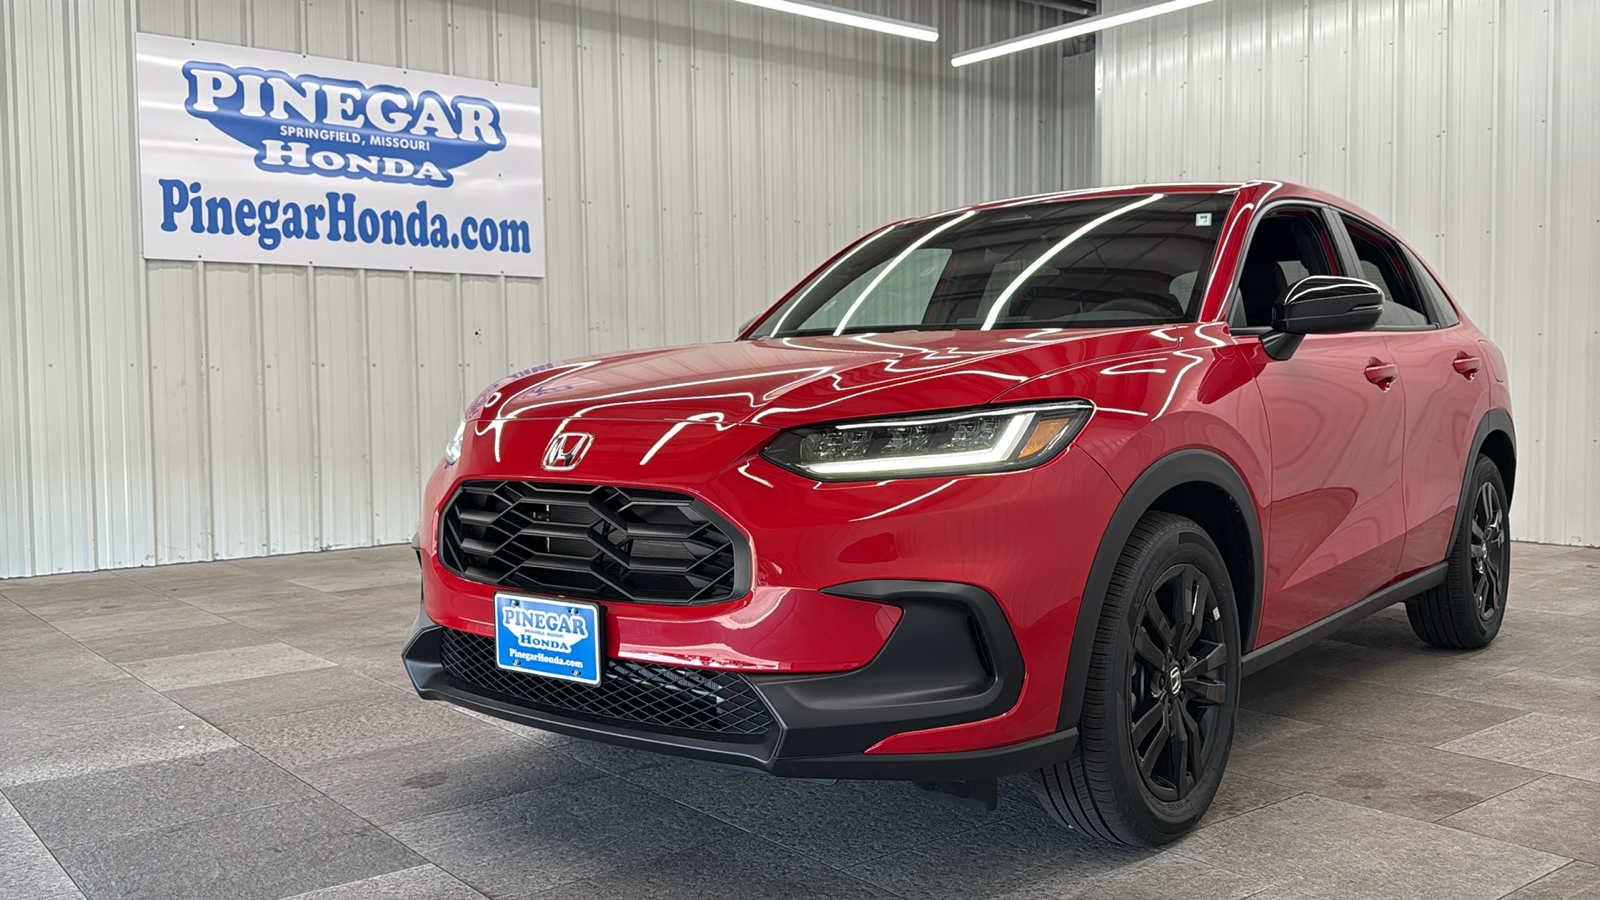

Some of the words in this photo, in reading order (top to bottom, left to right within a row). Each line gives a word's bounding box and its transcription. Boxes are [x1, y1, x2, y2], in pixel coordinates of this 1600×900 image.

[190, 68, 501, 145] PINEGAR
[279, 125, 366, 147] SPRINGFIELD,
[370, 135, 431, 152] MISSOURI
[261, 139, 448, 182] HONDA
[158, 178, 532, 254] PinegarHonda.com
[504, 609, 586, 635] PINEGAR
[520, 634, 569, 650] HONDA
[509, 648, 584, 668] PinegarHonda.com
